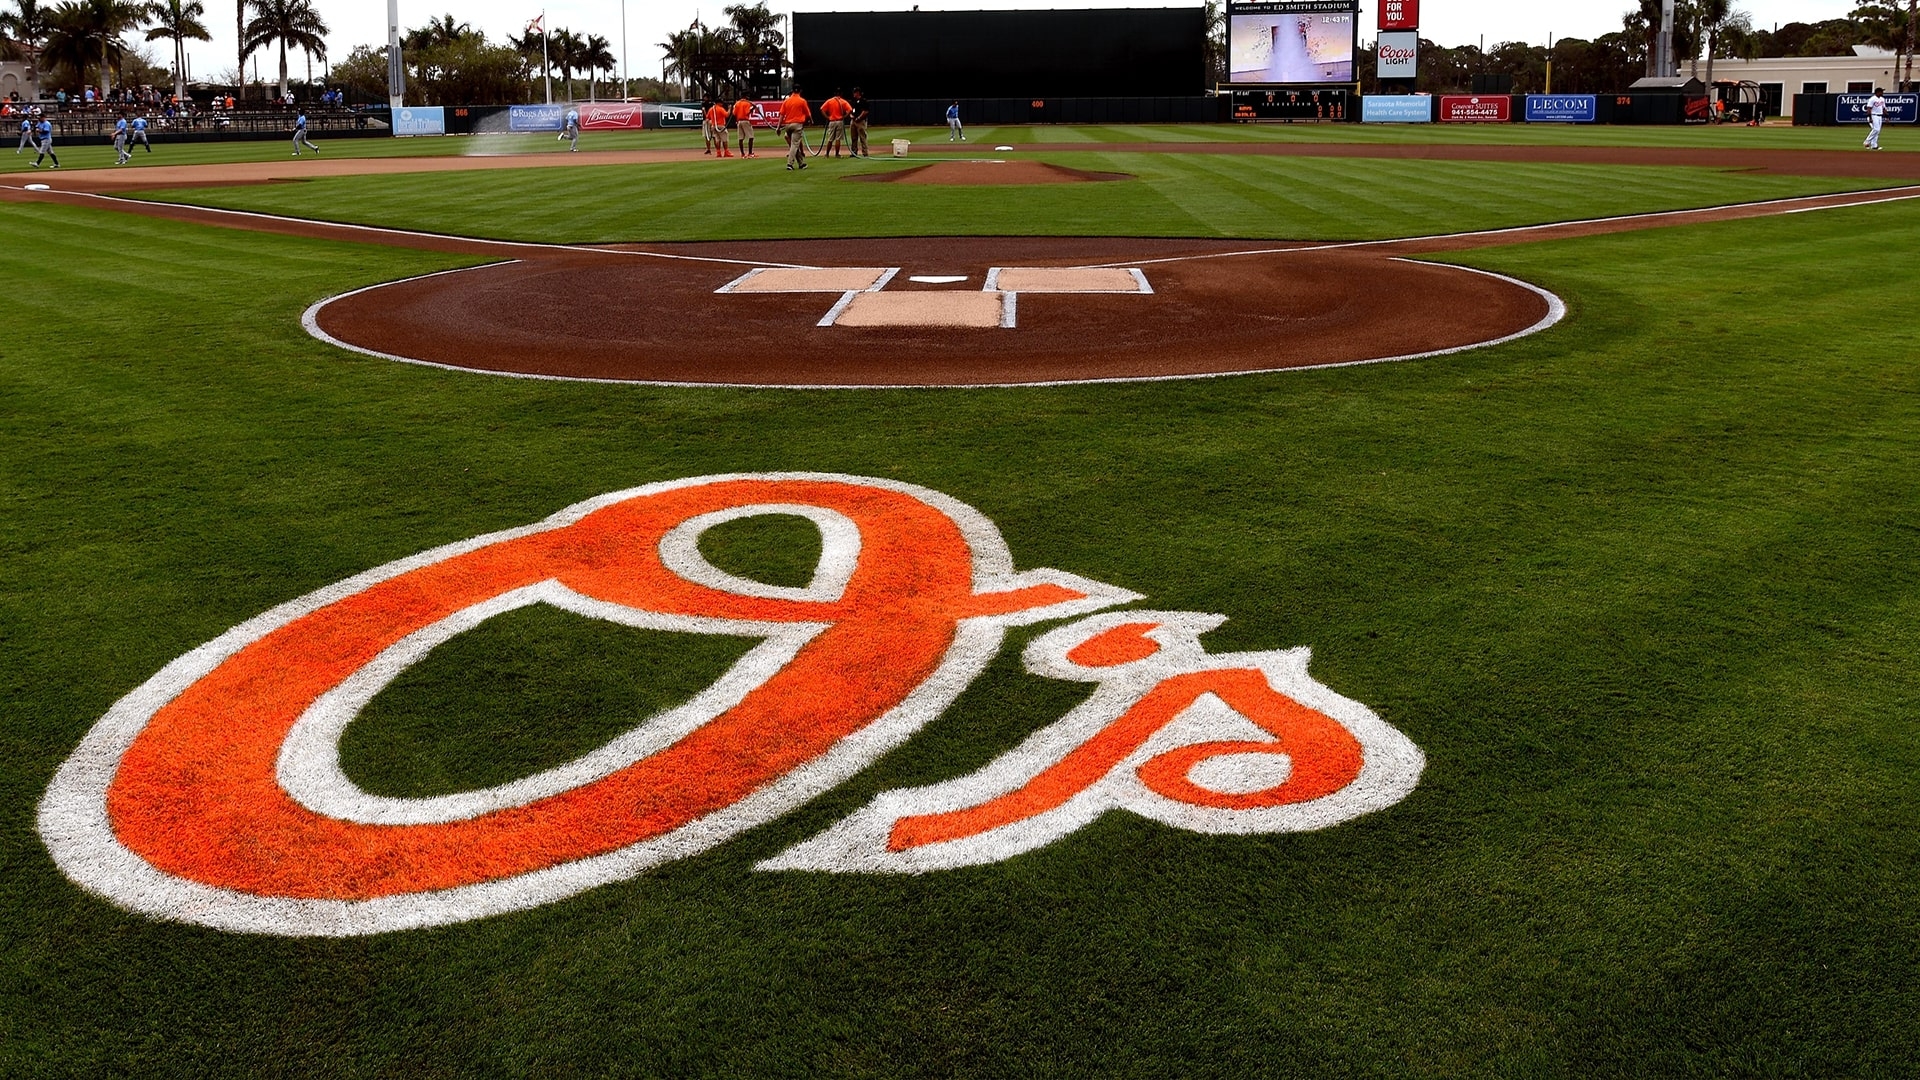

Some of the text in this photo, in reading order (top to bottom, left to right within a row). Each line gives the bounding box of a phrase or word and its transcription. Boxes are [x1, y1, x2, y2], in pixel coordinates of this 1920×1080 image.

[1386, 3, 1402, 11] FOR
[1386, 12, 1404, 20] YOU.
[1379, 45, 1415, 58] Coors
[1533, 99, 1588, 110] LECOM
[518, 109, 536, 119] Rugs
[538, 109, 548, 117] As
[548, 109, 559, 117] Art
[591, 111, 630, 120] Budweiser
[662, 111, 678, 120] FLY
[38, 471, 1426, 937] O's
